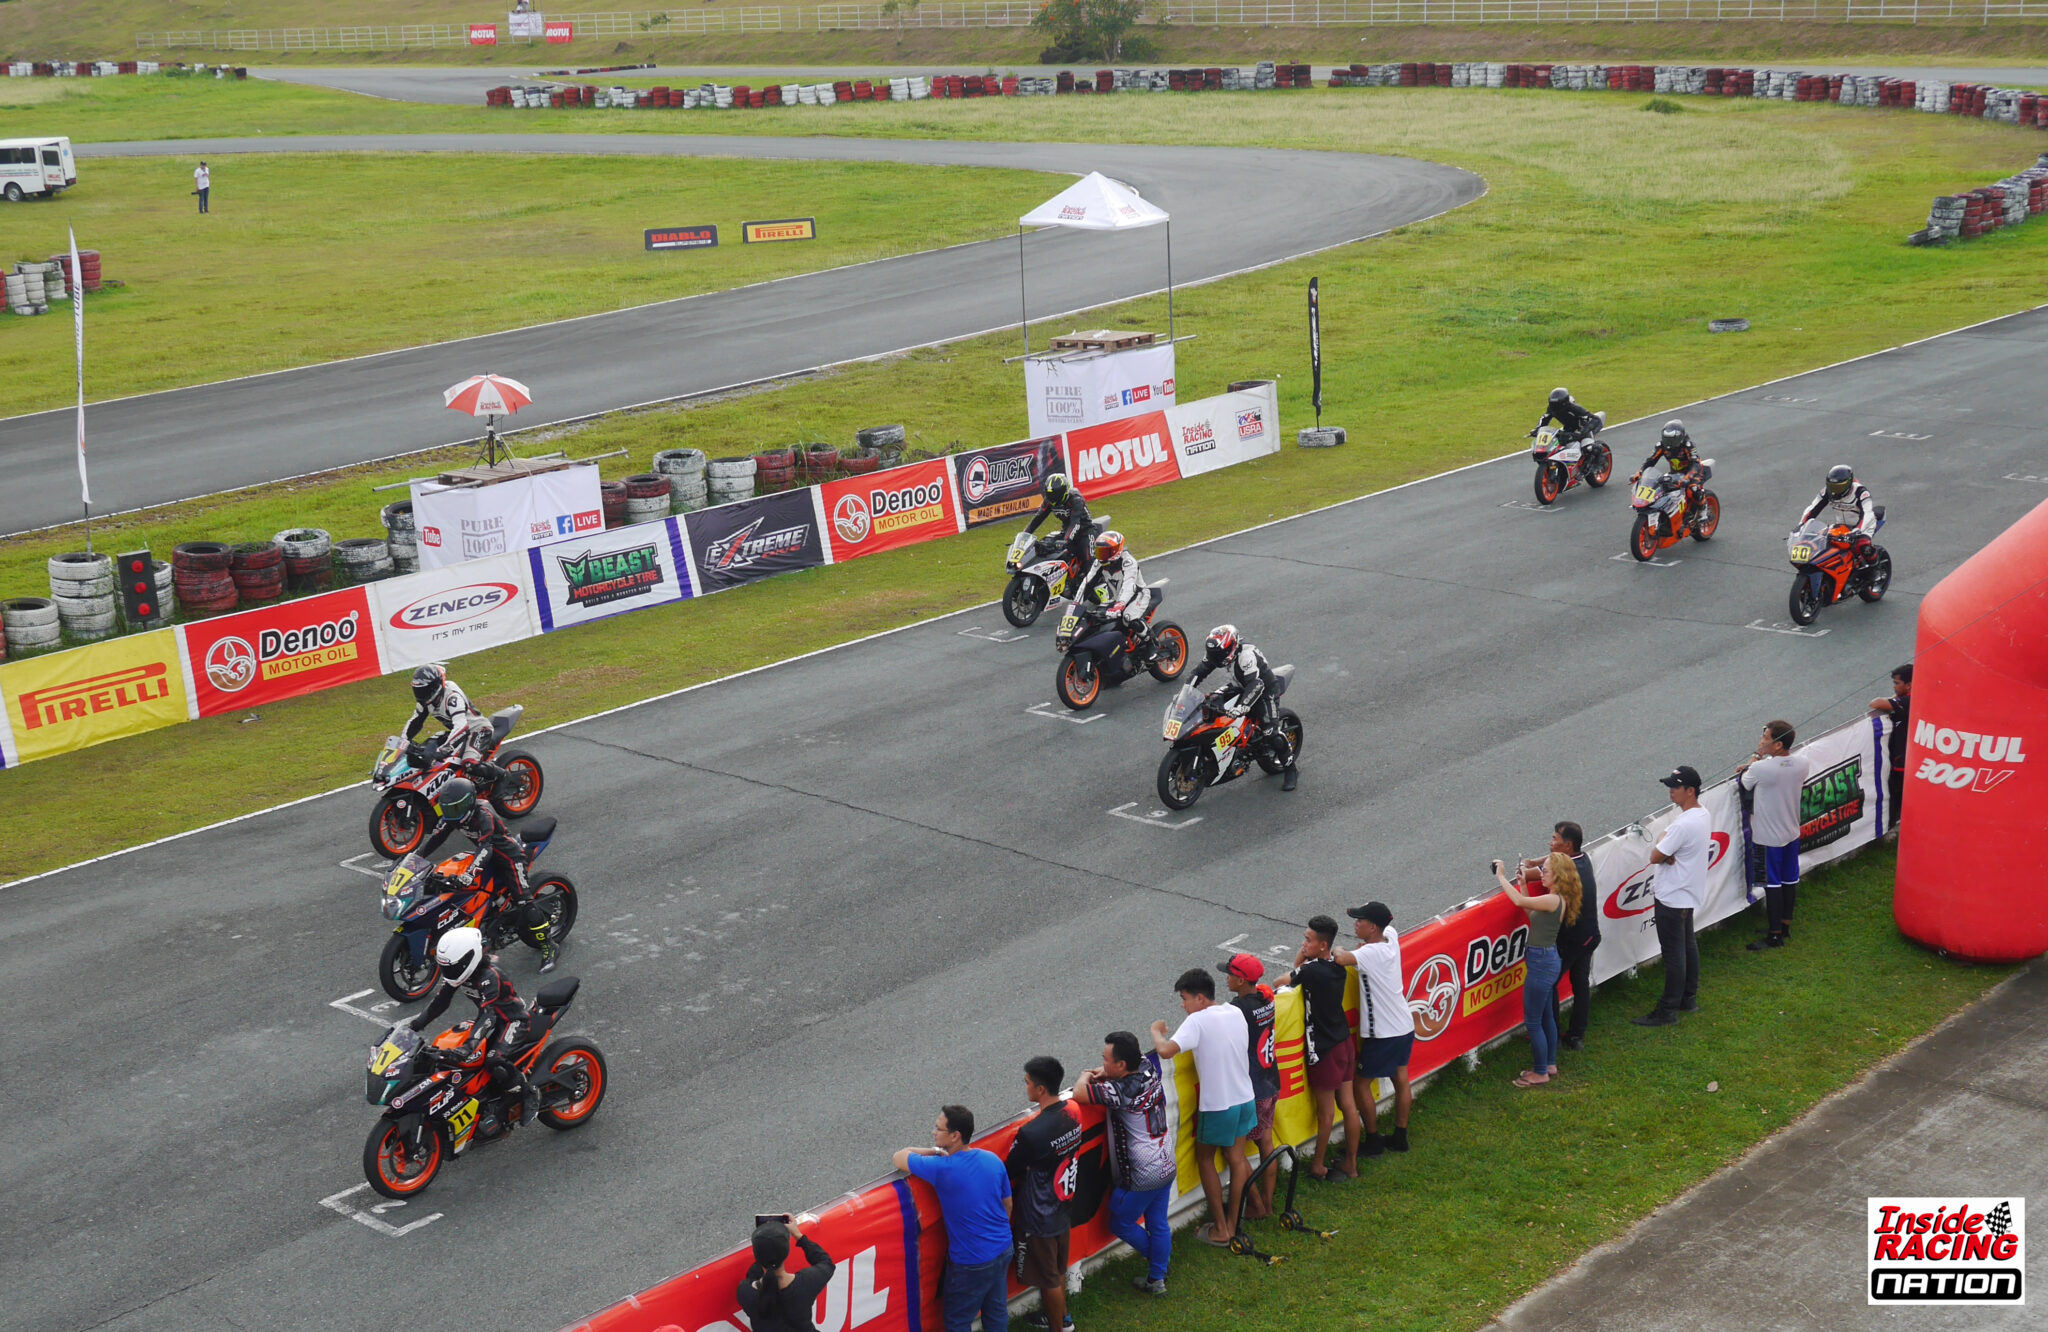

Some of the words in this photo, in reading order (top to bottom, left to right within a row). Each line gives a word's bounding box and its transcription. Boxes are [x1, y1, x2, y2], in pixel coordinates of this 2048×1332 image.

[471, 30, 496, 39] MOTUL
[546, 28, 570, 37] MOTUL
[651, 231, 711, 243] DIABLO
[755, 225, 803, 239] PIRELLI
[1045, 386, 1083, 396] PURE
[1134, 389, 1149, 400] LIVE
[1049, 401, 1081, 414] 100%
[1182, 423, 1205, 436] Inside
[1184, 429, 1213, 445] RACING
[1240, 423, 1262, 436] USRA
[1078, 432, 1168, 483] MOTUL
[964, 455, 1033, 503] QUICK
[870, 482, 943, 517] Denoo
[977, 507, 993, 518] MADE
[994, 505, 1001, 514] IN
[1002, 499, 1030, 513] THAILAND
[461, 516, 504, 532] PURE
[577, 514, 598, 527] LIVE
[878, 513, 917, 530] MOTOR
[920, 508, 938, 520] OIL
[465, 536, 502, 553] 100%
[706, 520, 806, 570] EXTREME
[1792, 546, 1808, 560] 30
[588, 547, 654, 582] BEAST
[573, 575, 635, 599] MOTORCYCLE
[636, 570, 658, 584] TIRE
[1053, 583, 1062, 596] 22
[408, 589, 502, 622] ZENEOS
[260, 617, 356, 660] Denoo
[432, 630, 449, 641] IT'S
[451, 626, 466, 636] MY
[468, 621, 489, 632] TIRE
[268, 653, 322, 675] MOTOR
[327, 647, 351, 661] OIL
[18, 661, 170, 730] PIRELLI
[1165, 721, 1180, 737] 95
[1219, 731, 1232, 748] 95
[1914, 719, 2026, 763] MOTUL
[426, 770, 456, 797] KTM
[1915, 757, 2015, 793] 300V
[1800, 764, 1858, 823] BEAST
[1800, 809, 1837, 839] RCYCLE
[1838, 799, 1860, 820] TIRE
[437, 908, 459, 929] CUP
[1465, 925, 1528, 988] Den
[1470, 967, 1524, 1008] MOTOR
[429, 1088, 455, 1115] CUP
[454, 1109, 473, 1127] 71
[1050, 1130, 1073, 1147] POWER
